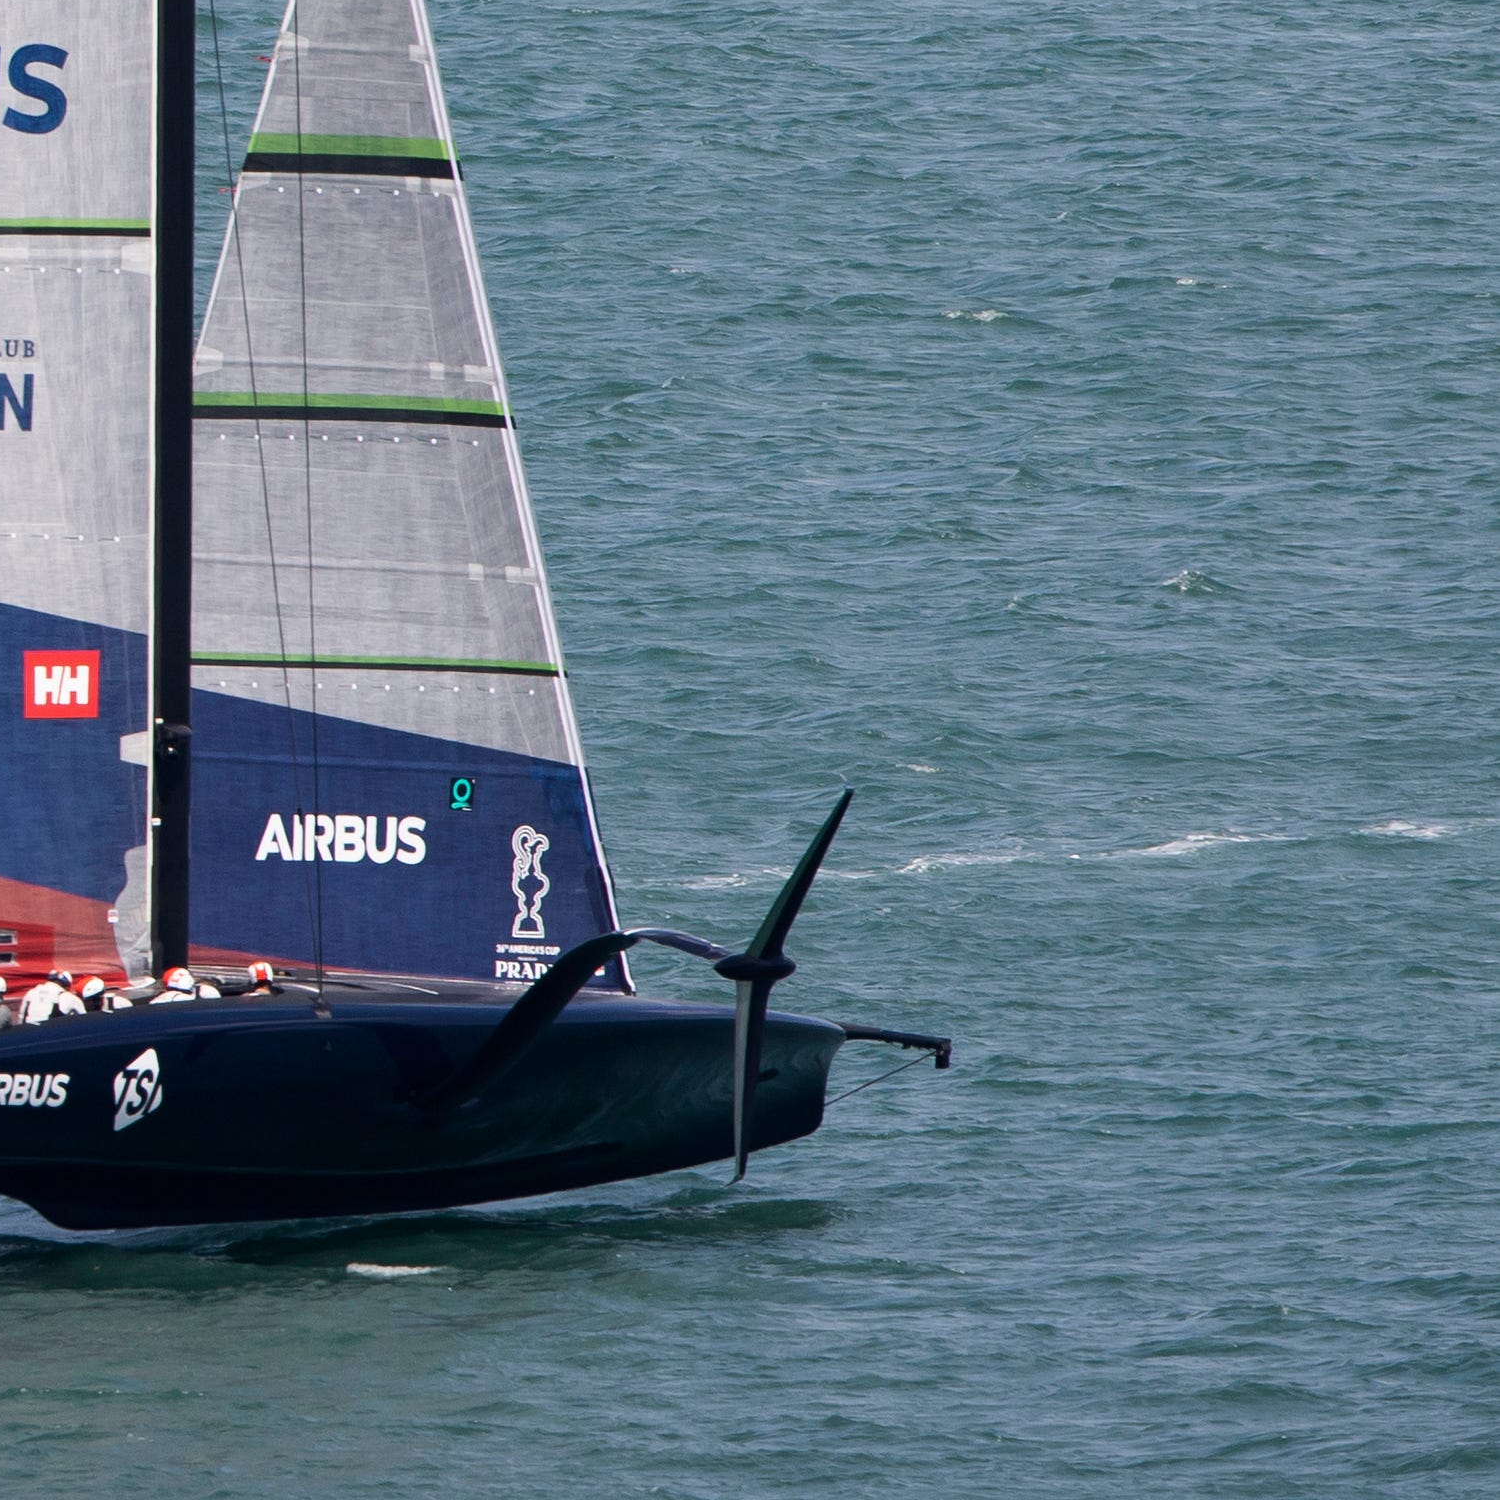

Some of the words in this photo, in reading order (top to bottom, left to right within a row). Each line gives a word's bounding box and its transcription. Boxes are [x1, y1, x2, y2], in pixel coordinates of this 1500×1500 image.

[34, 665, 90, 705] HH
[255, 814, 427, 865] AIRBUS
[495, 960, 554, 979] PRAD
